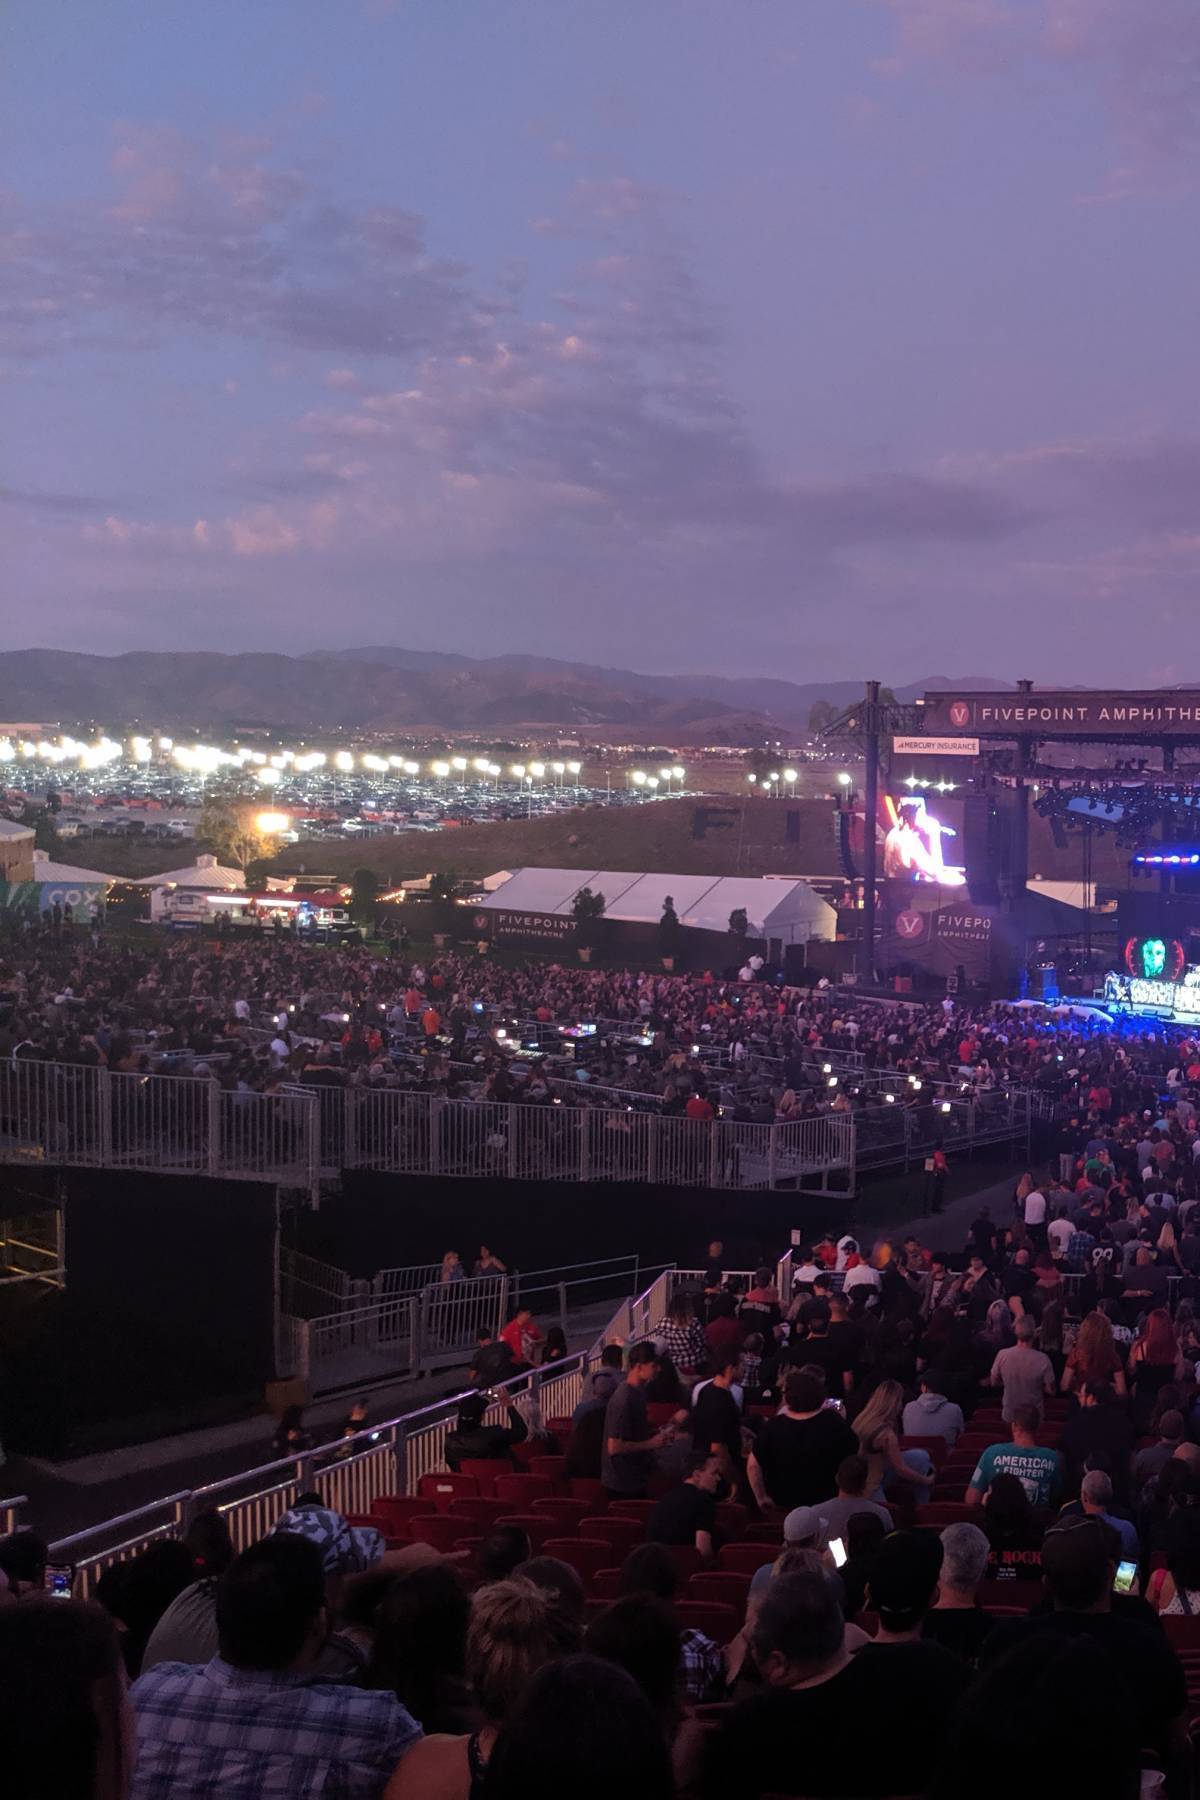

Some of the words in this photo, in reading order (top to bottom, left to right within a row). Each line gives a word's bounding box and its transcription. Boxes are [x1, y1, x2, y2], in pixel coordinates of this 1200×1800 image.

[982, 707, 1088, 721] FIVEPOINT
[937, 742, 976, 750] INSURANCE
[499, 915, 578, 930] FIVEPOINT
[937, 915, 992, 929] FIVEPO
[499, 927, 564, 938] AMPHITHEATRE
[993, 1455, 1056, 1472] AMERICAN
[1003, 1466, 1045, 1478] FIGHTER
